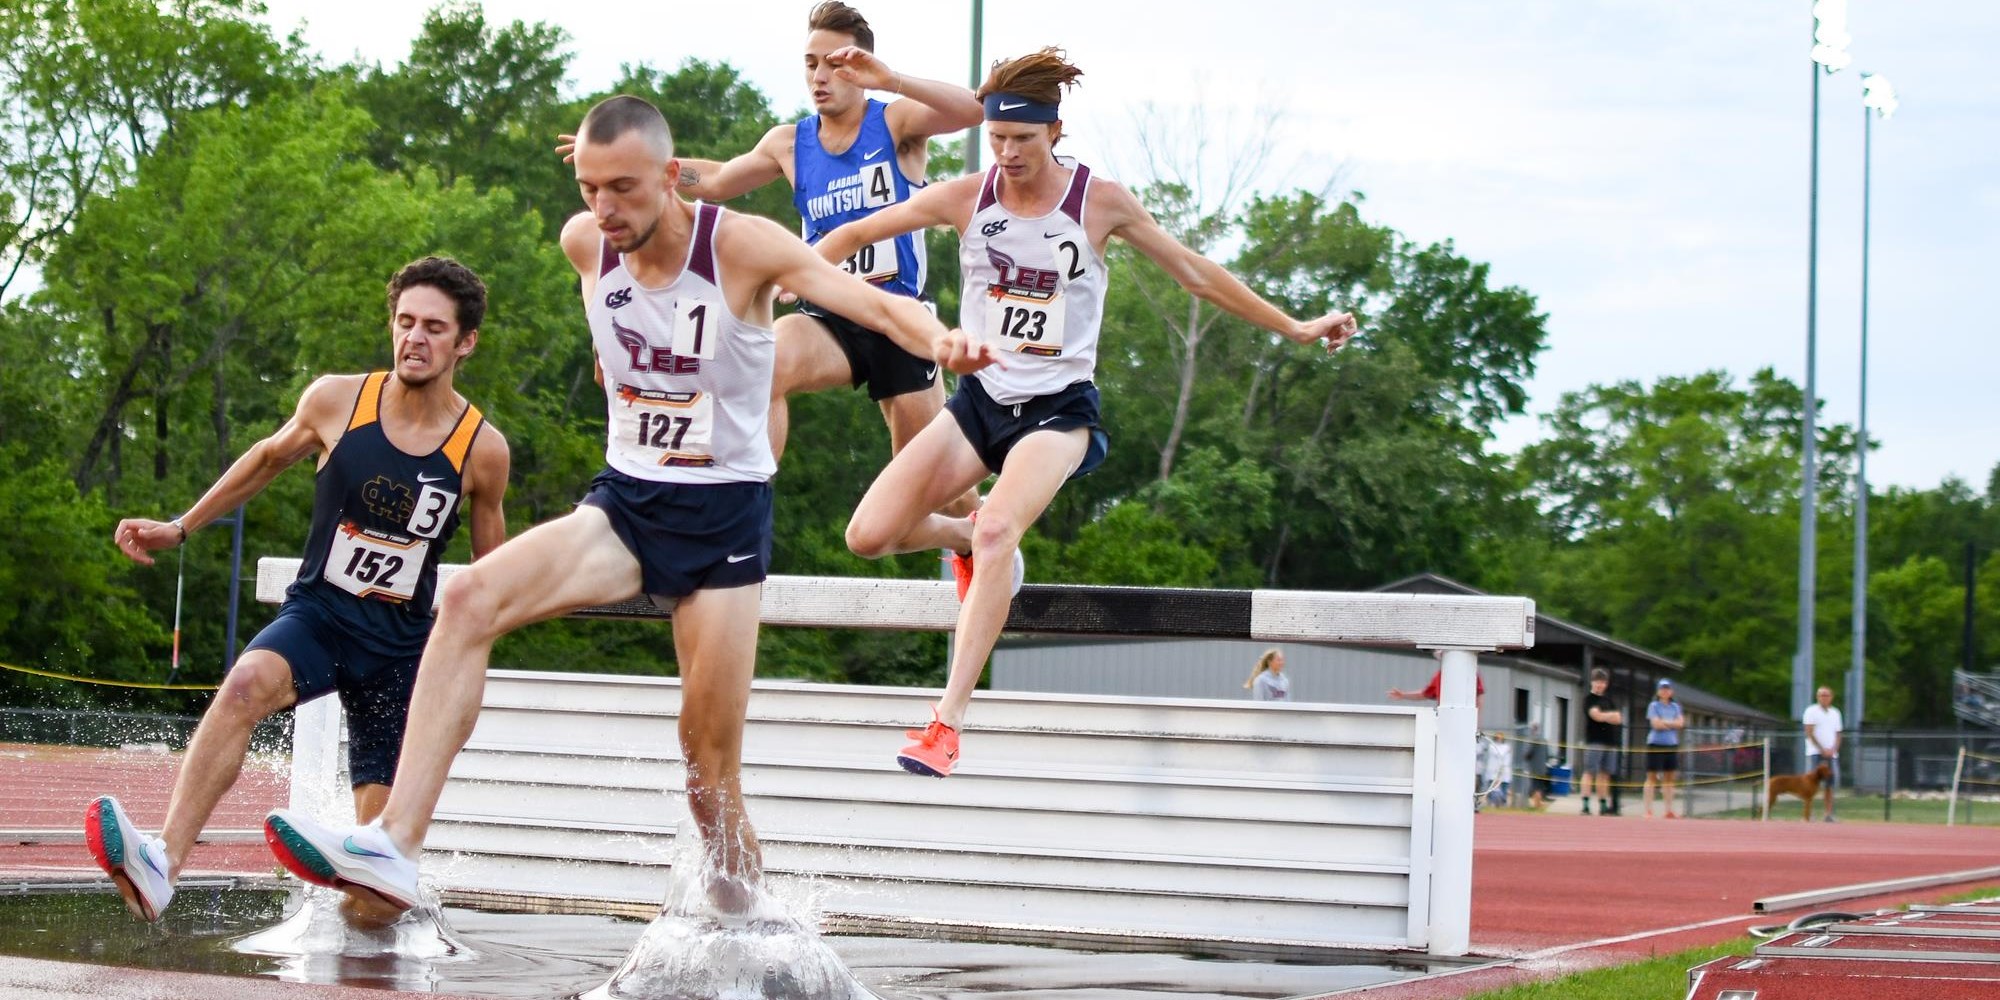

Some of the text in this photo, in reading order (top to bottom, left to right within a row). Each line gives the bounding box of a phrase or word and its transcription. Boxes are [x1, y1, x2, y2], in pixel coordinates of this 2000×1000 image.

[870, 166, 890, 203] 4
[981, 219, 1009, 237] GSC
[999, 264, 1061, 293] LEE
[1059, 240, 1086, 281] 2
[605, 287, 632, 309] GSC
[688, 304, 707, 355] 1
[1000, 306, 1047, 342] 123
[628, 343, 700, 375] LEE
[638, 412, 693, 451] 127
[415, 491, 447, 534] 3
[343, 546, 404, 589] 152
